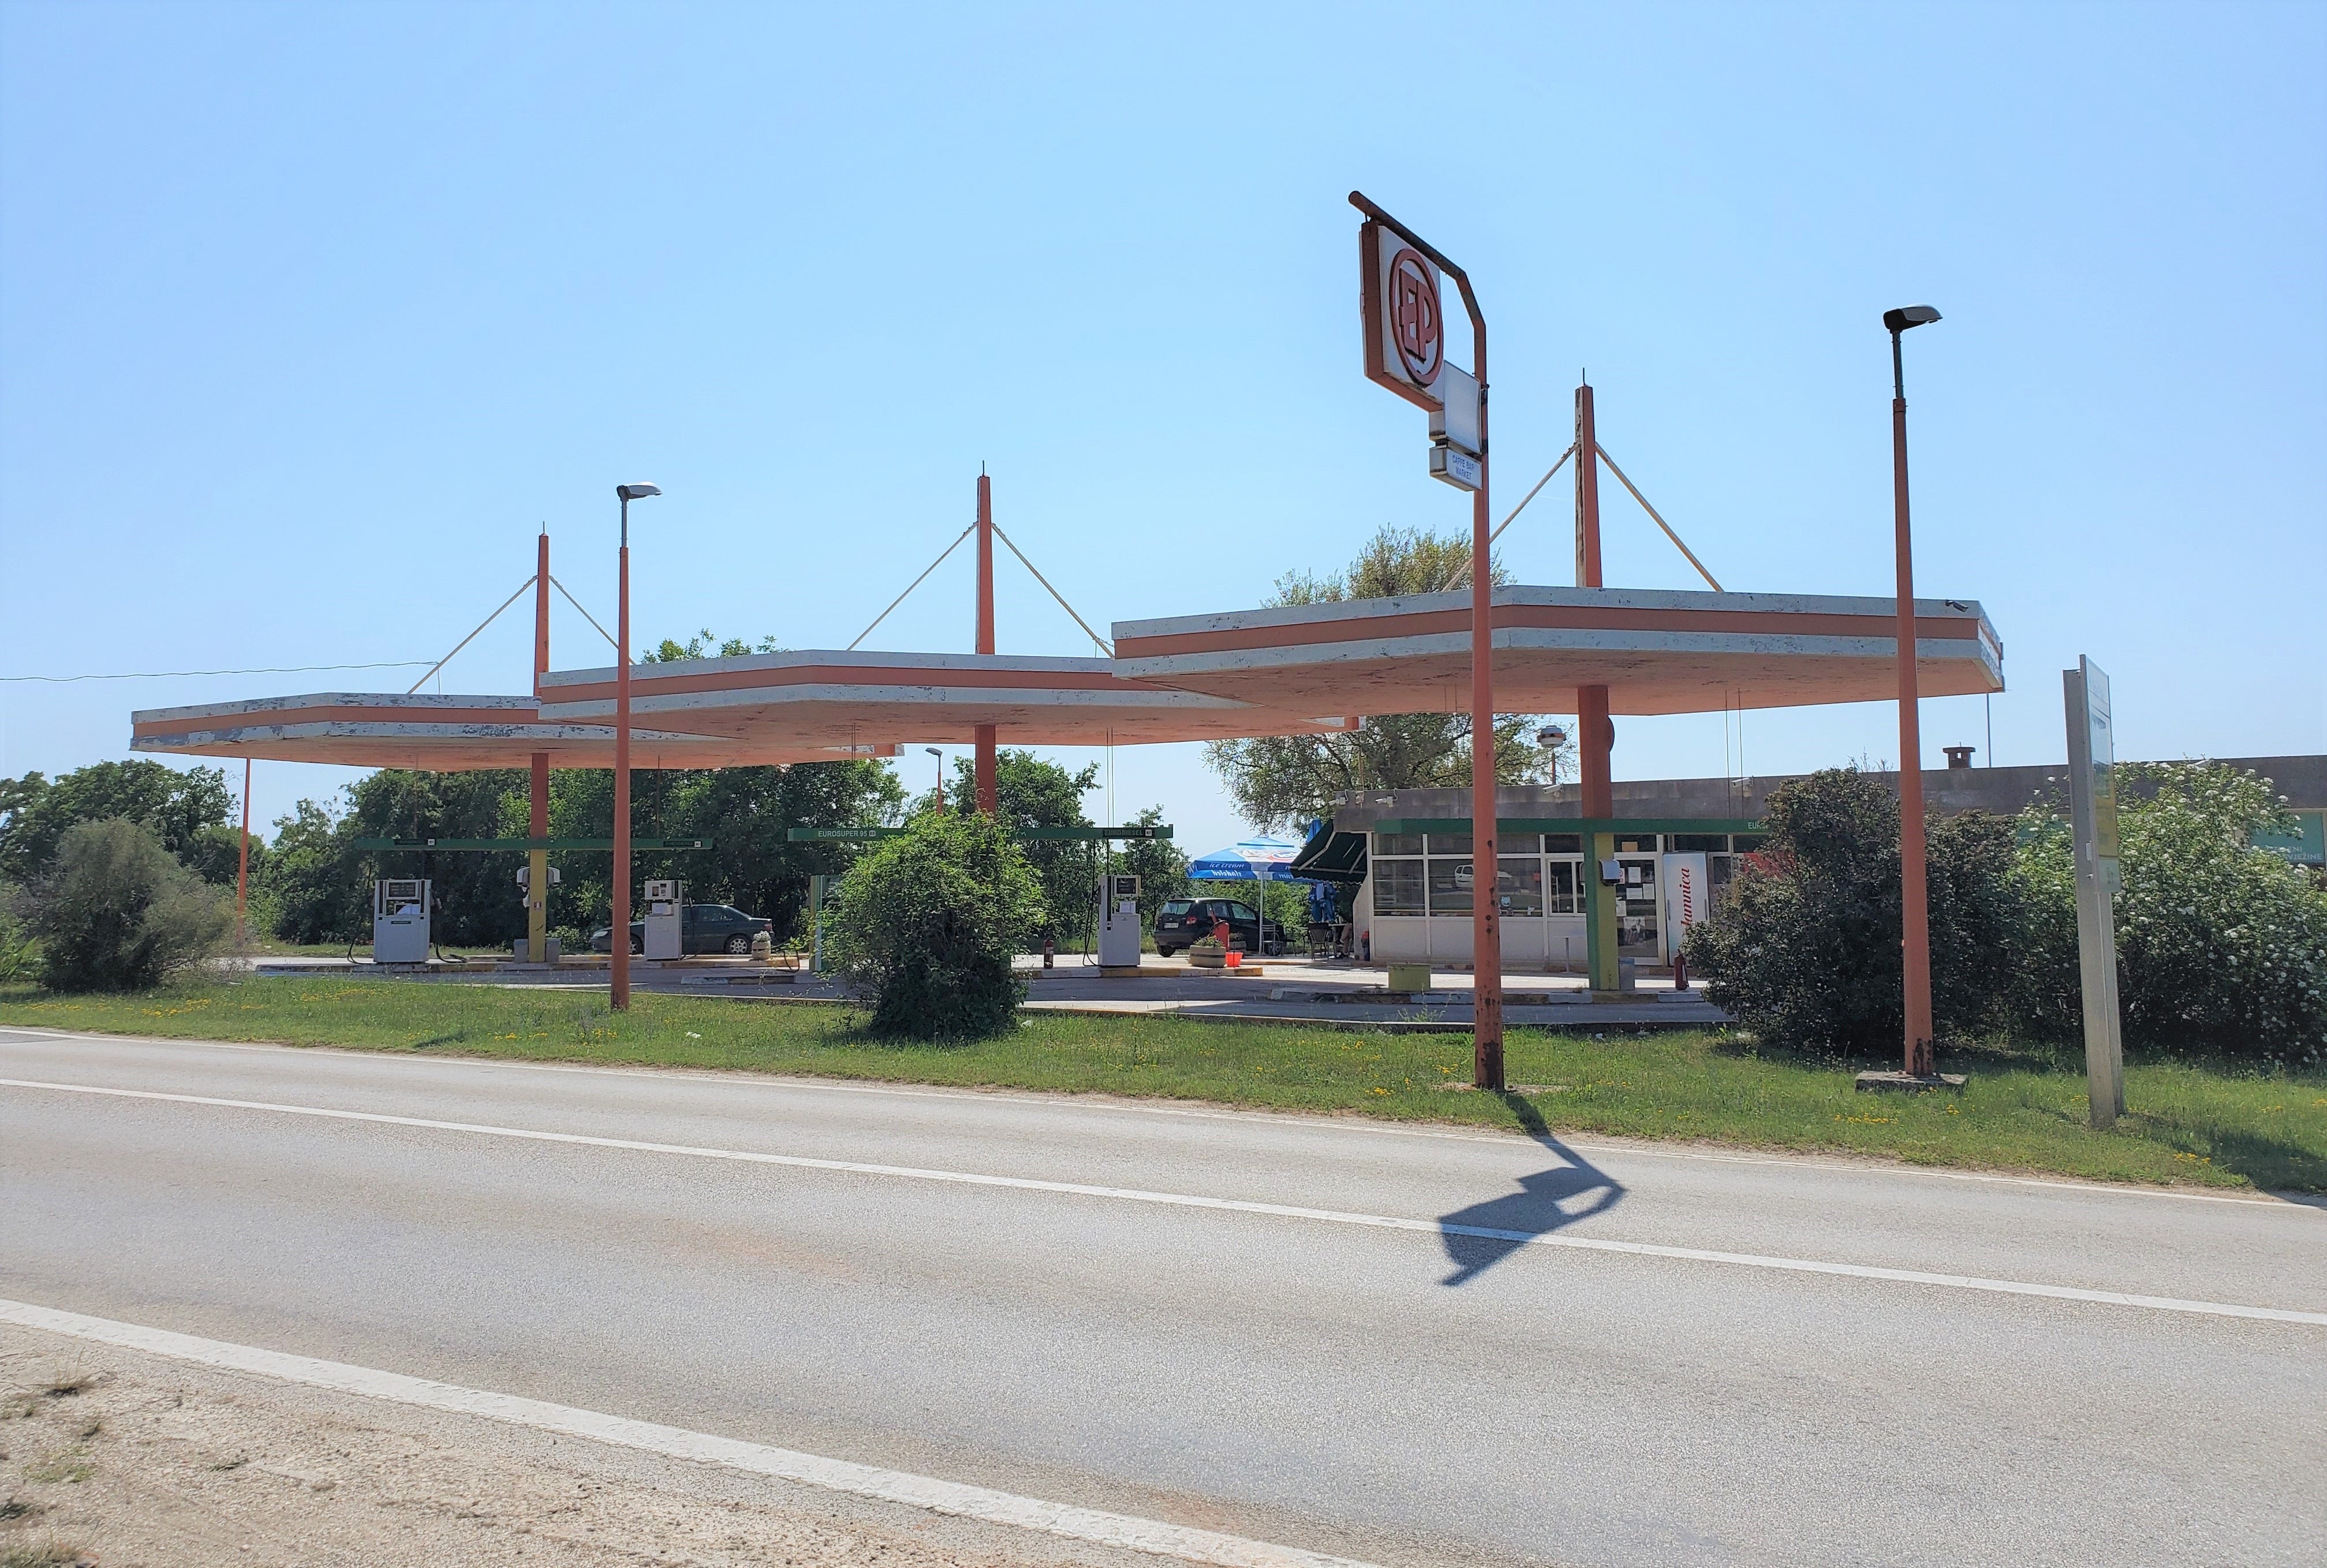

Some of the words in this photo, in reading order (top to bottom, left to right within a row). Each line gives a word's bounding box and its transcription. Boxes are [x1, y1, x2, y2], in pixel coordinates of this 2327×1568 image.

[1452, 455, 1465, 467] CAFFE
[1466, 461, 1474, 471] BAR
[1455, 467, 1471, 480] MARKET
